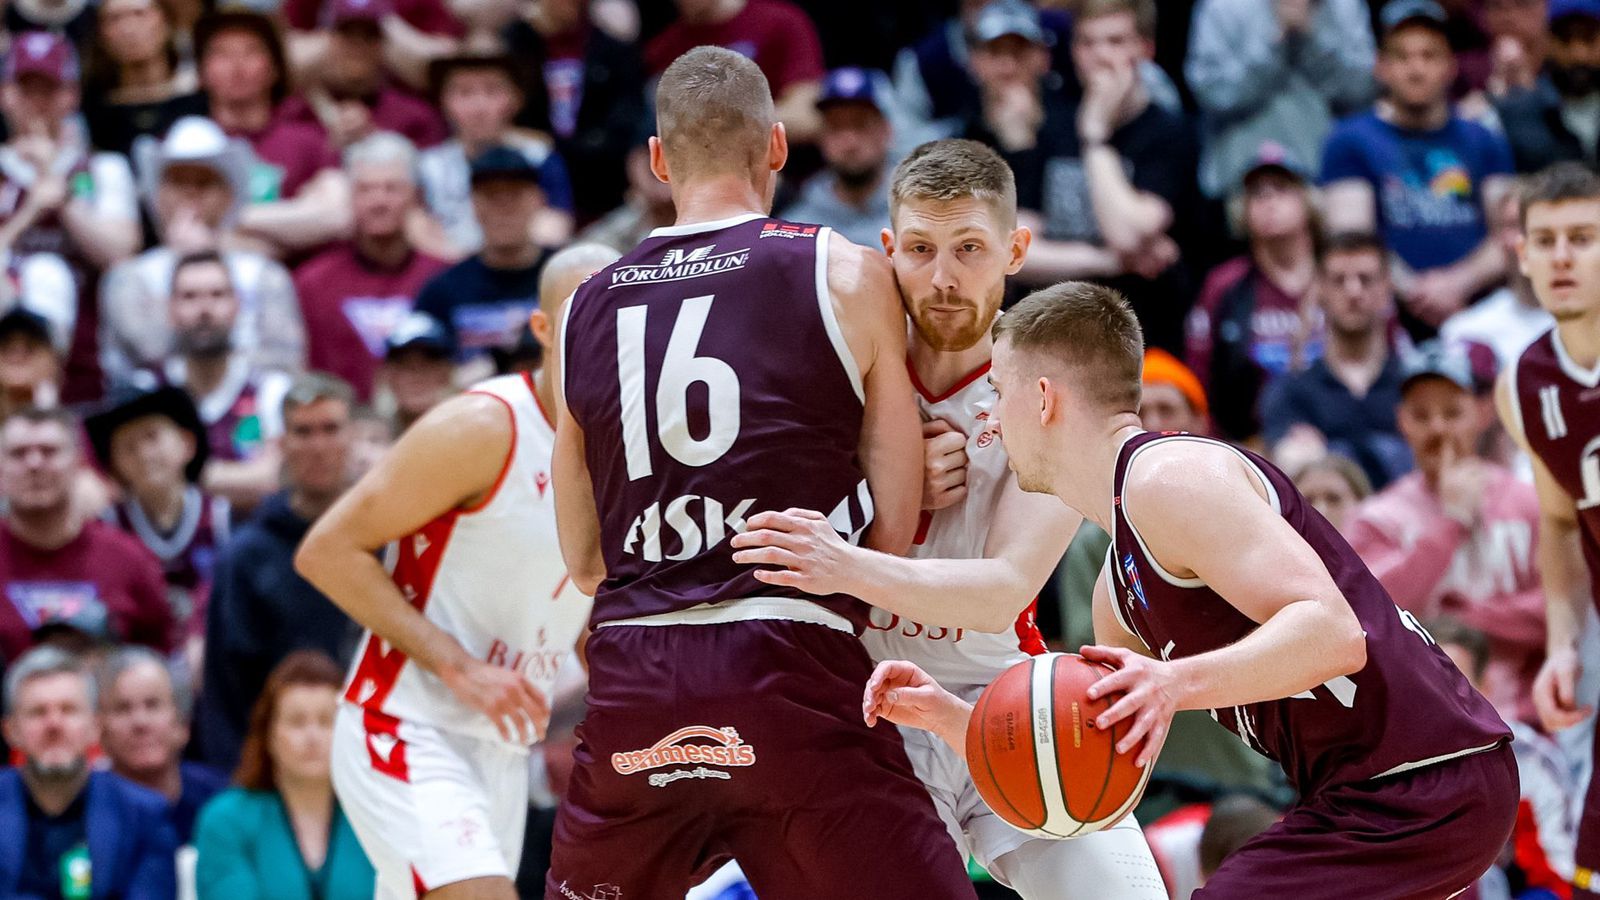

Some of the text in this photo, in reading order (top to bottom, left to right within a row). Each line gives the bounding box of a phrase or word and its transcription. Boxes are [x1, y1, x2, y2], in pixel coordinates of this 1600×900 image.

[611, 254, 745, 284] VÖRUMIÐLUN
[617, 294, 741, 481] 16
[1539, 384, 1568, 441] 11
